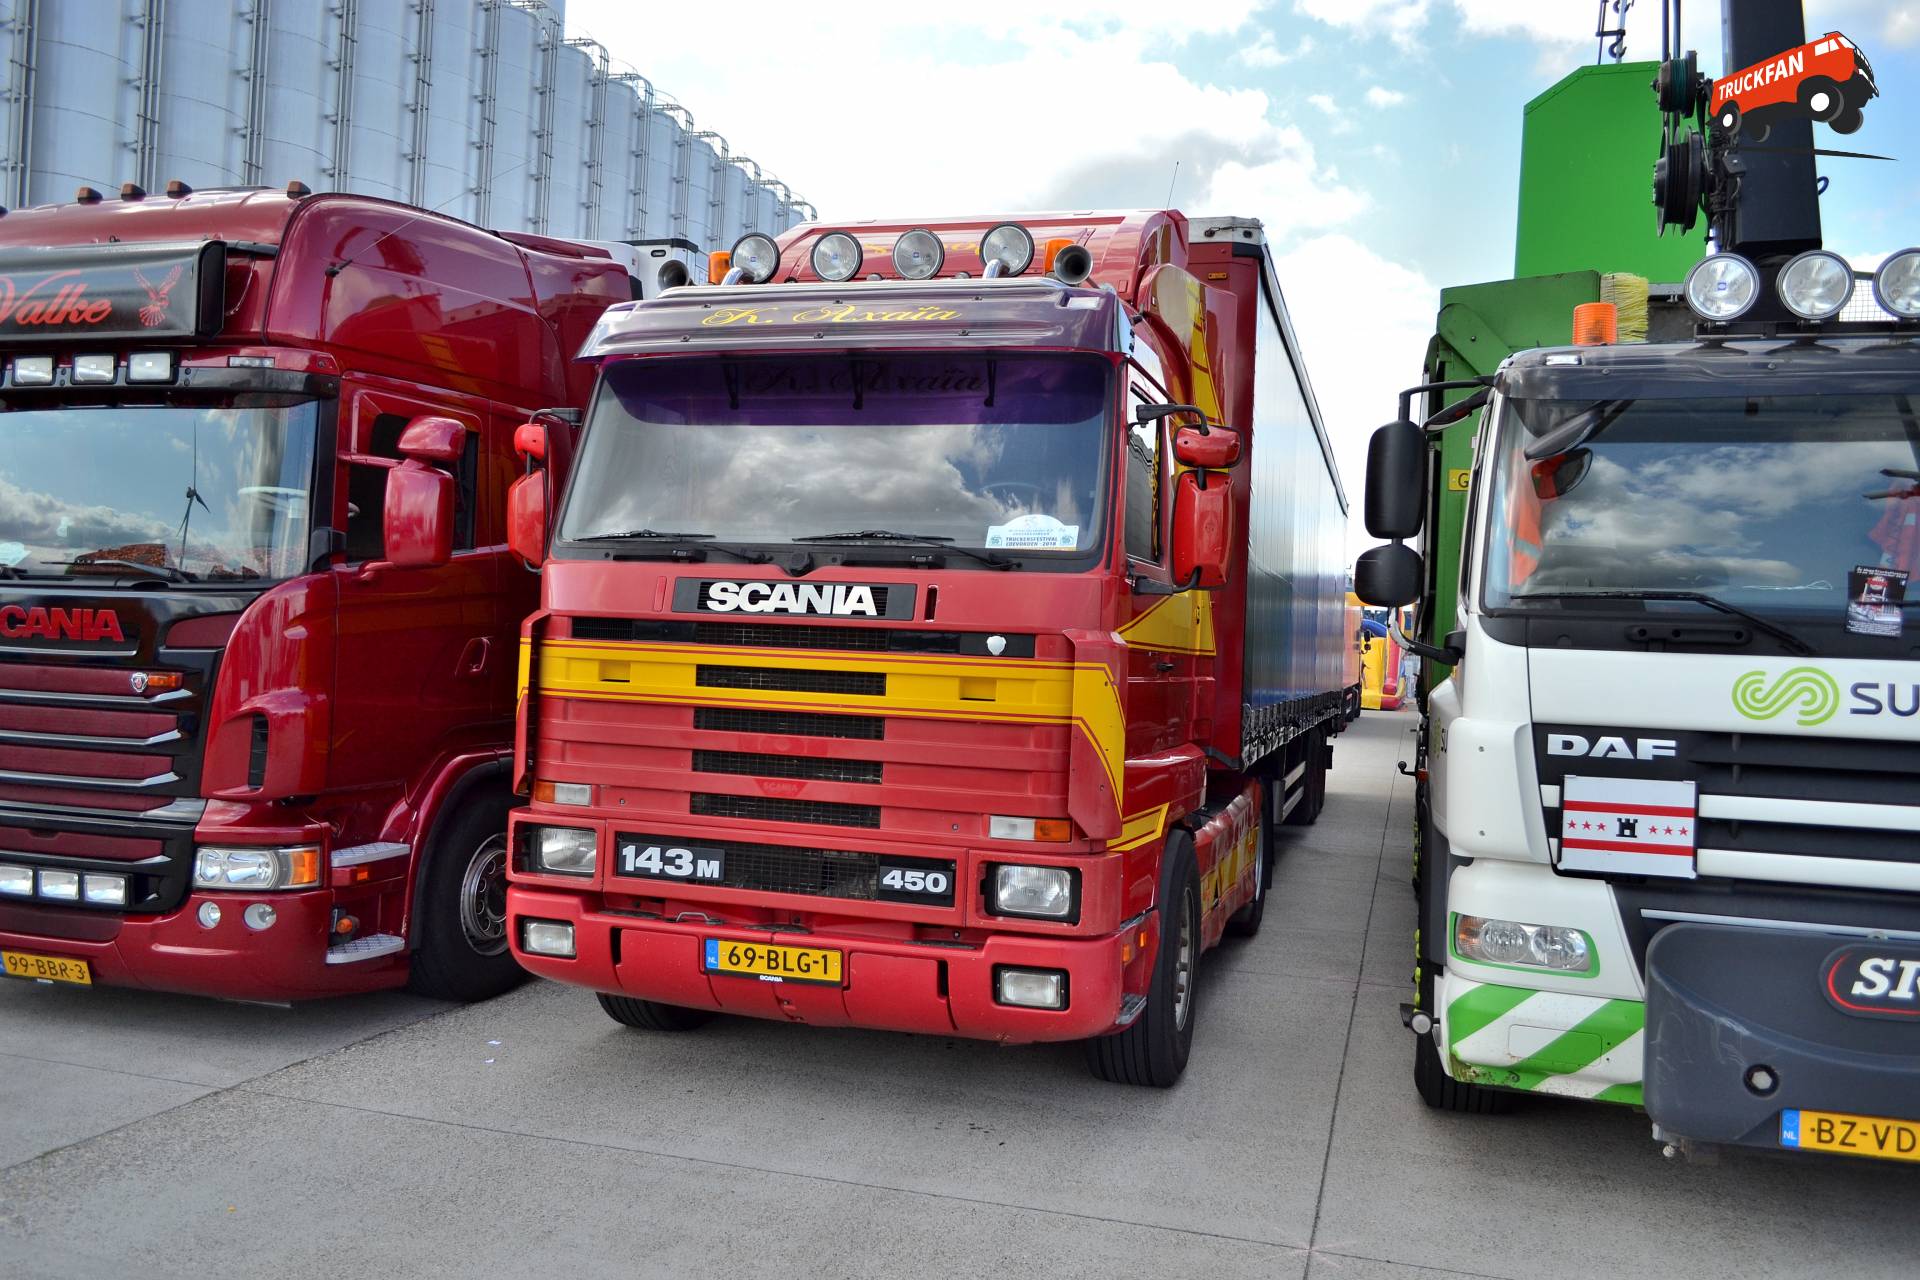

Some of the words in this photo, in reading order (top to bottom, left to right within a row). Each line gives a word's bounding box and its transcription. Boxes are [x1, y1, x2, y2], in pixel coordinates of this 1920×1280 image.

[706, 581, 878, 616] SCANIA
[1547, 733, 1677, 761] DAF
[882, 869, 948, 893] 450
[8, 955, 85, 980] 99-BBR-3
[727, 945, 828, 975] 69-BLG-1
[1783, 1130, 1797, 1140] NL
